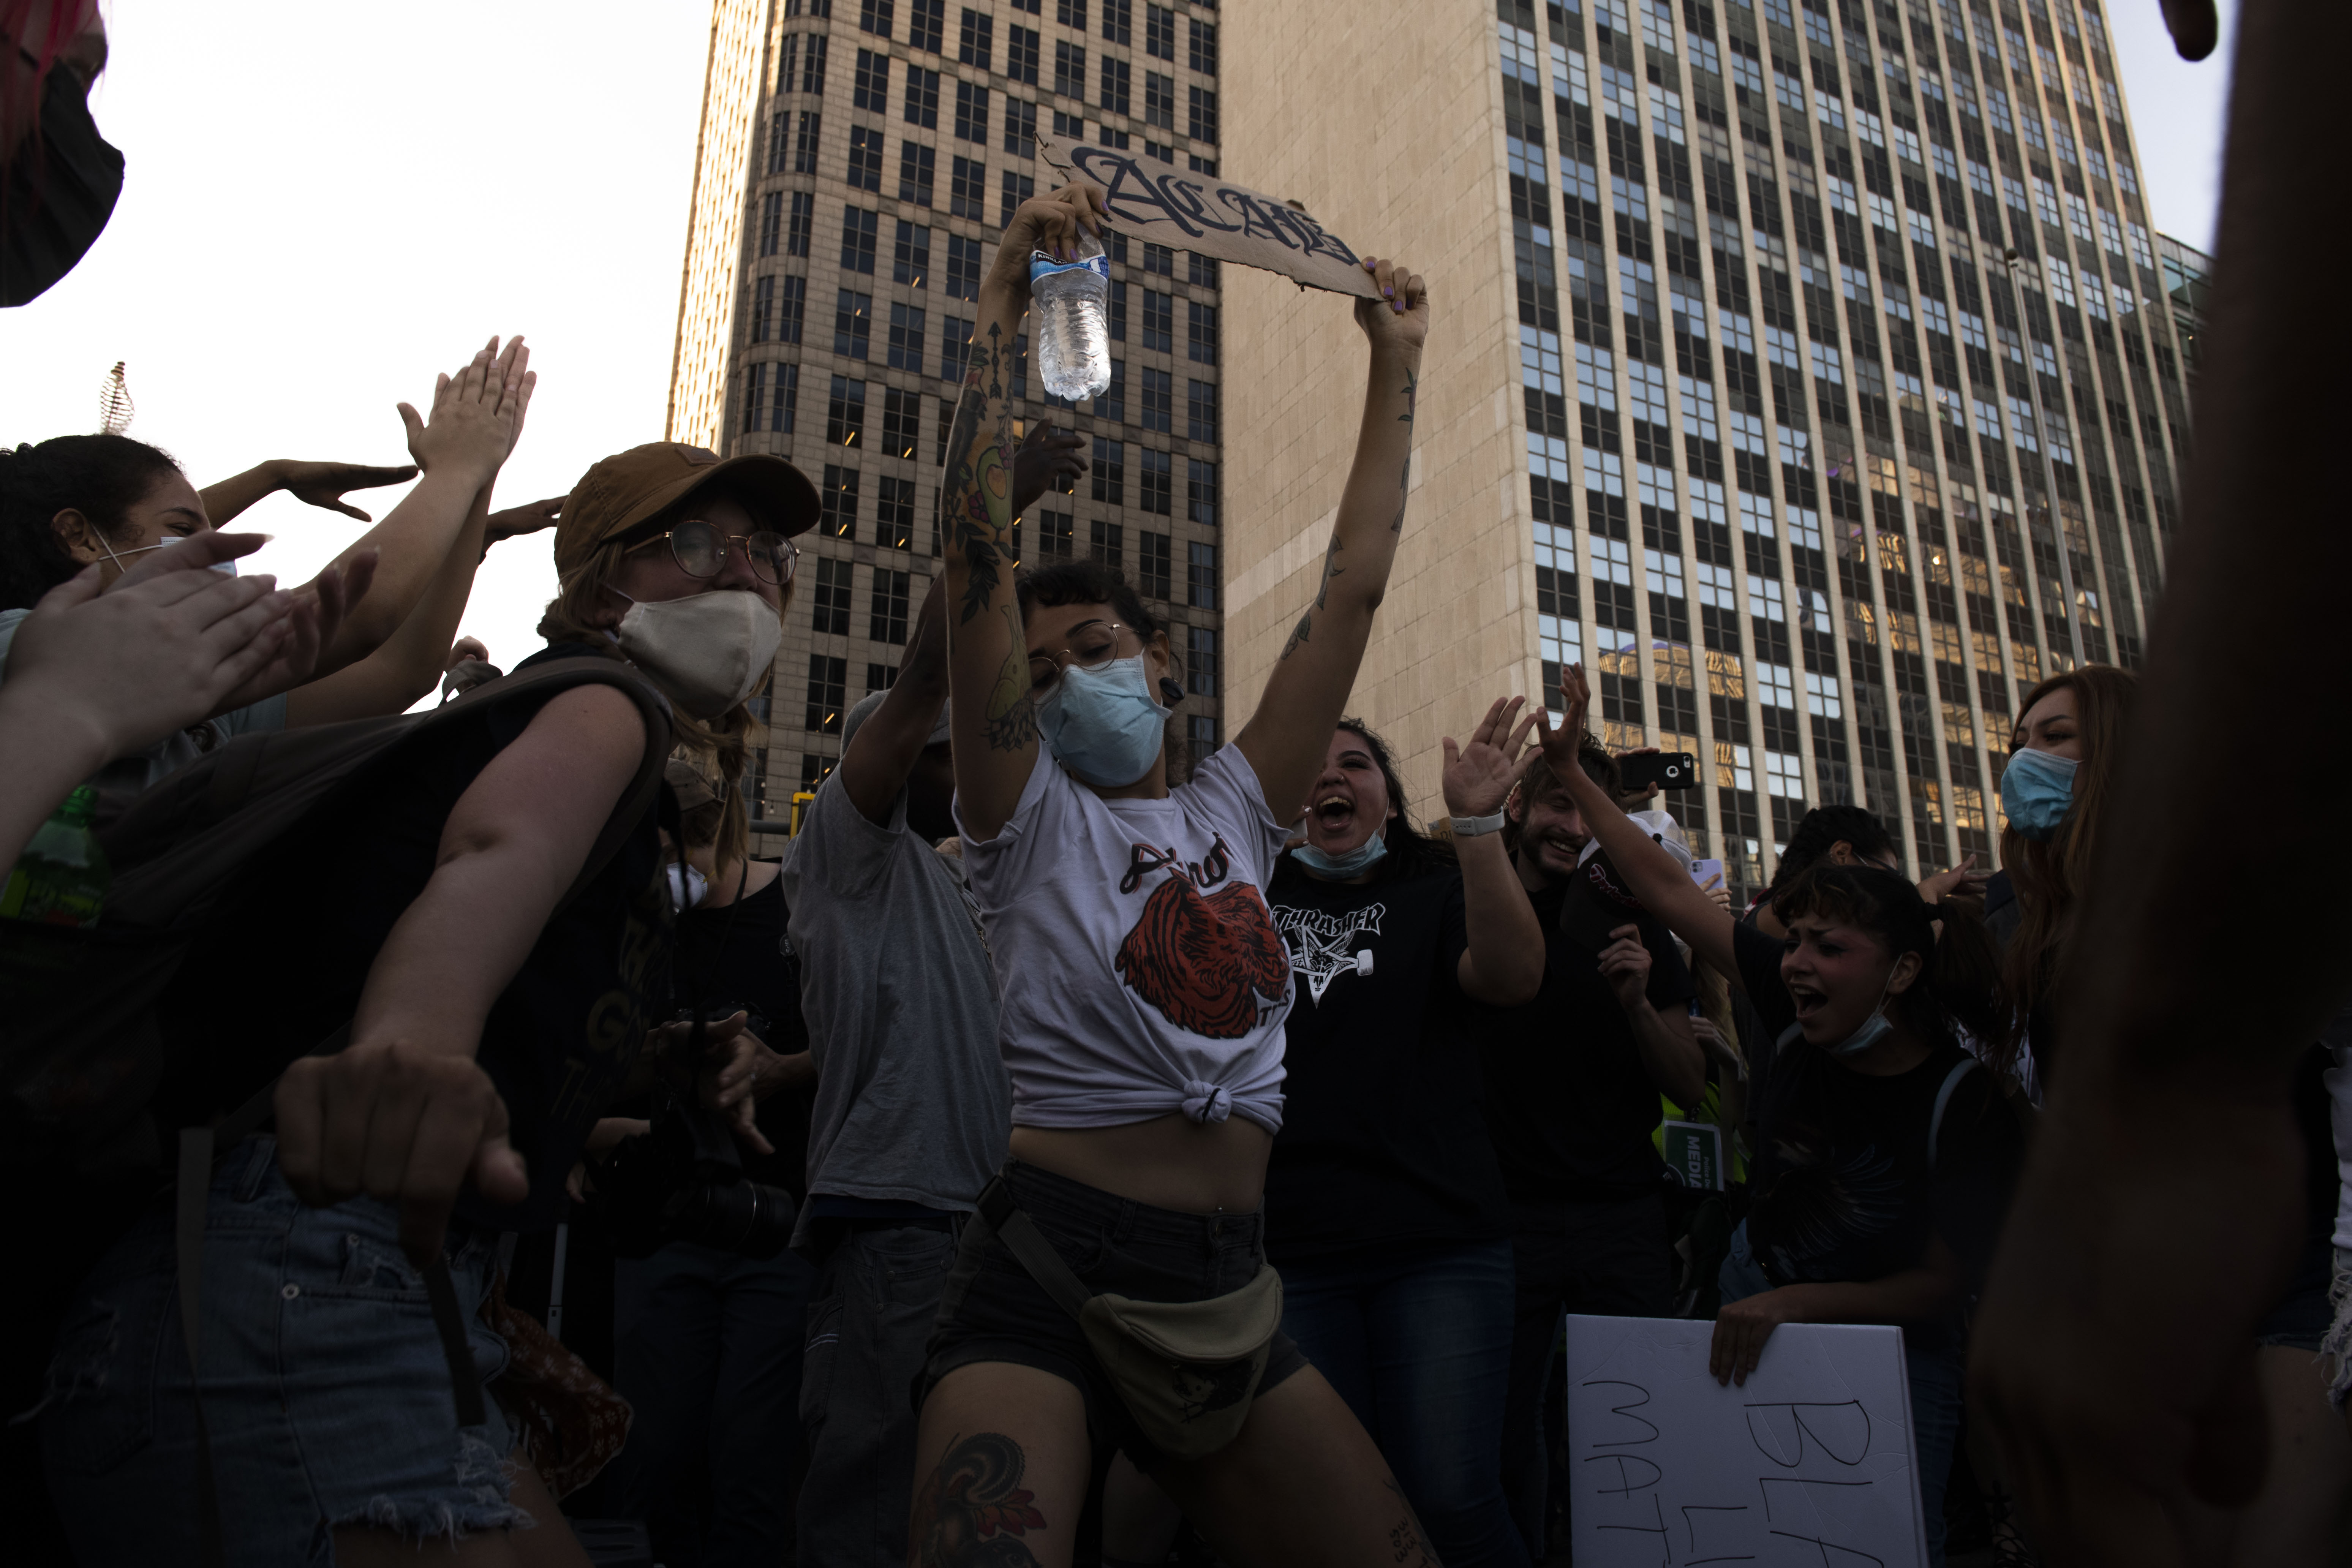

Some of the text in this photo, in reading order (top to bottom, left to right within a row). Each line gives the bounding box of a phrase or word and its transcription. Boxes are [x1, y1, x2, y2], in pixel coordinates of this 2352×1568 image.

[1038, 253, 1069, 264] KIRKLA
[1272, 902, 1386, 936] THRASHER
[1686, 1135, 1702, 1189] MEDIA
[1583, 1380, 1671, 1568] MAT
